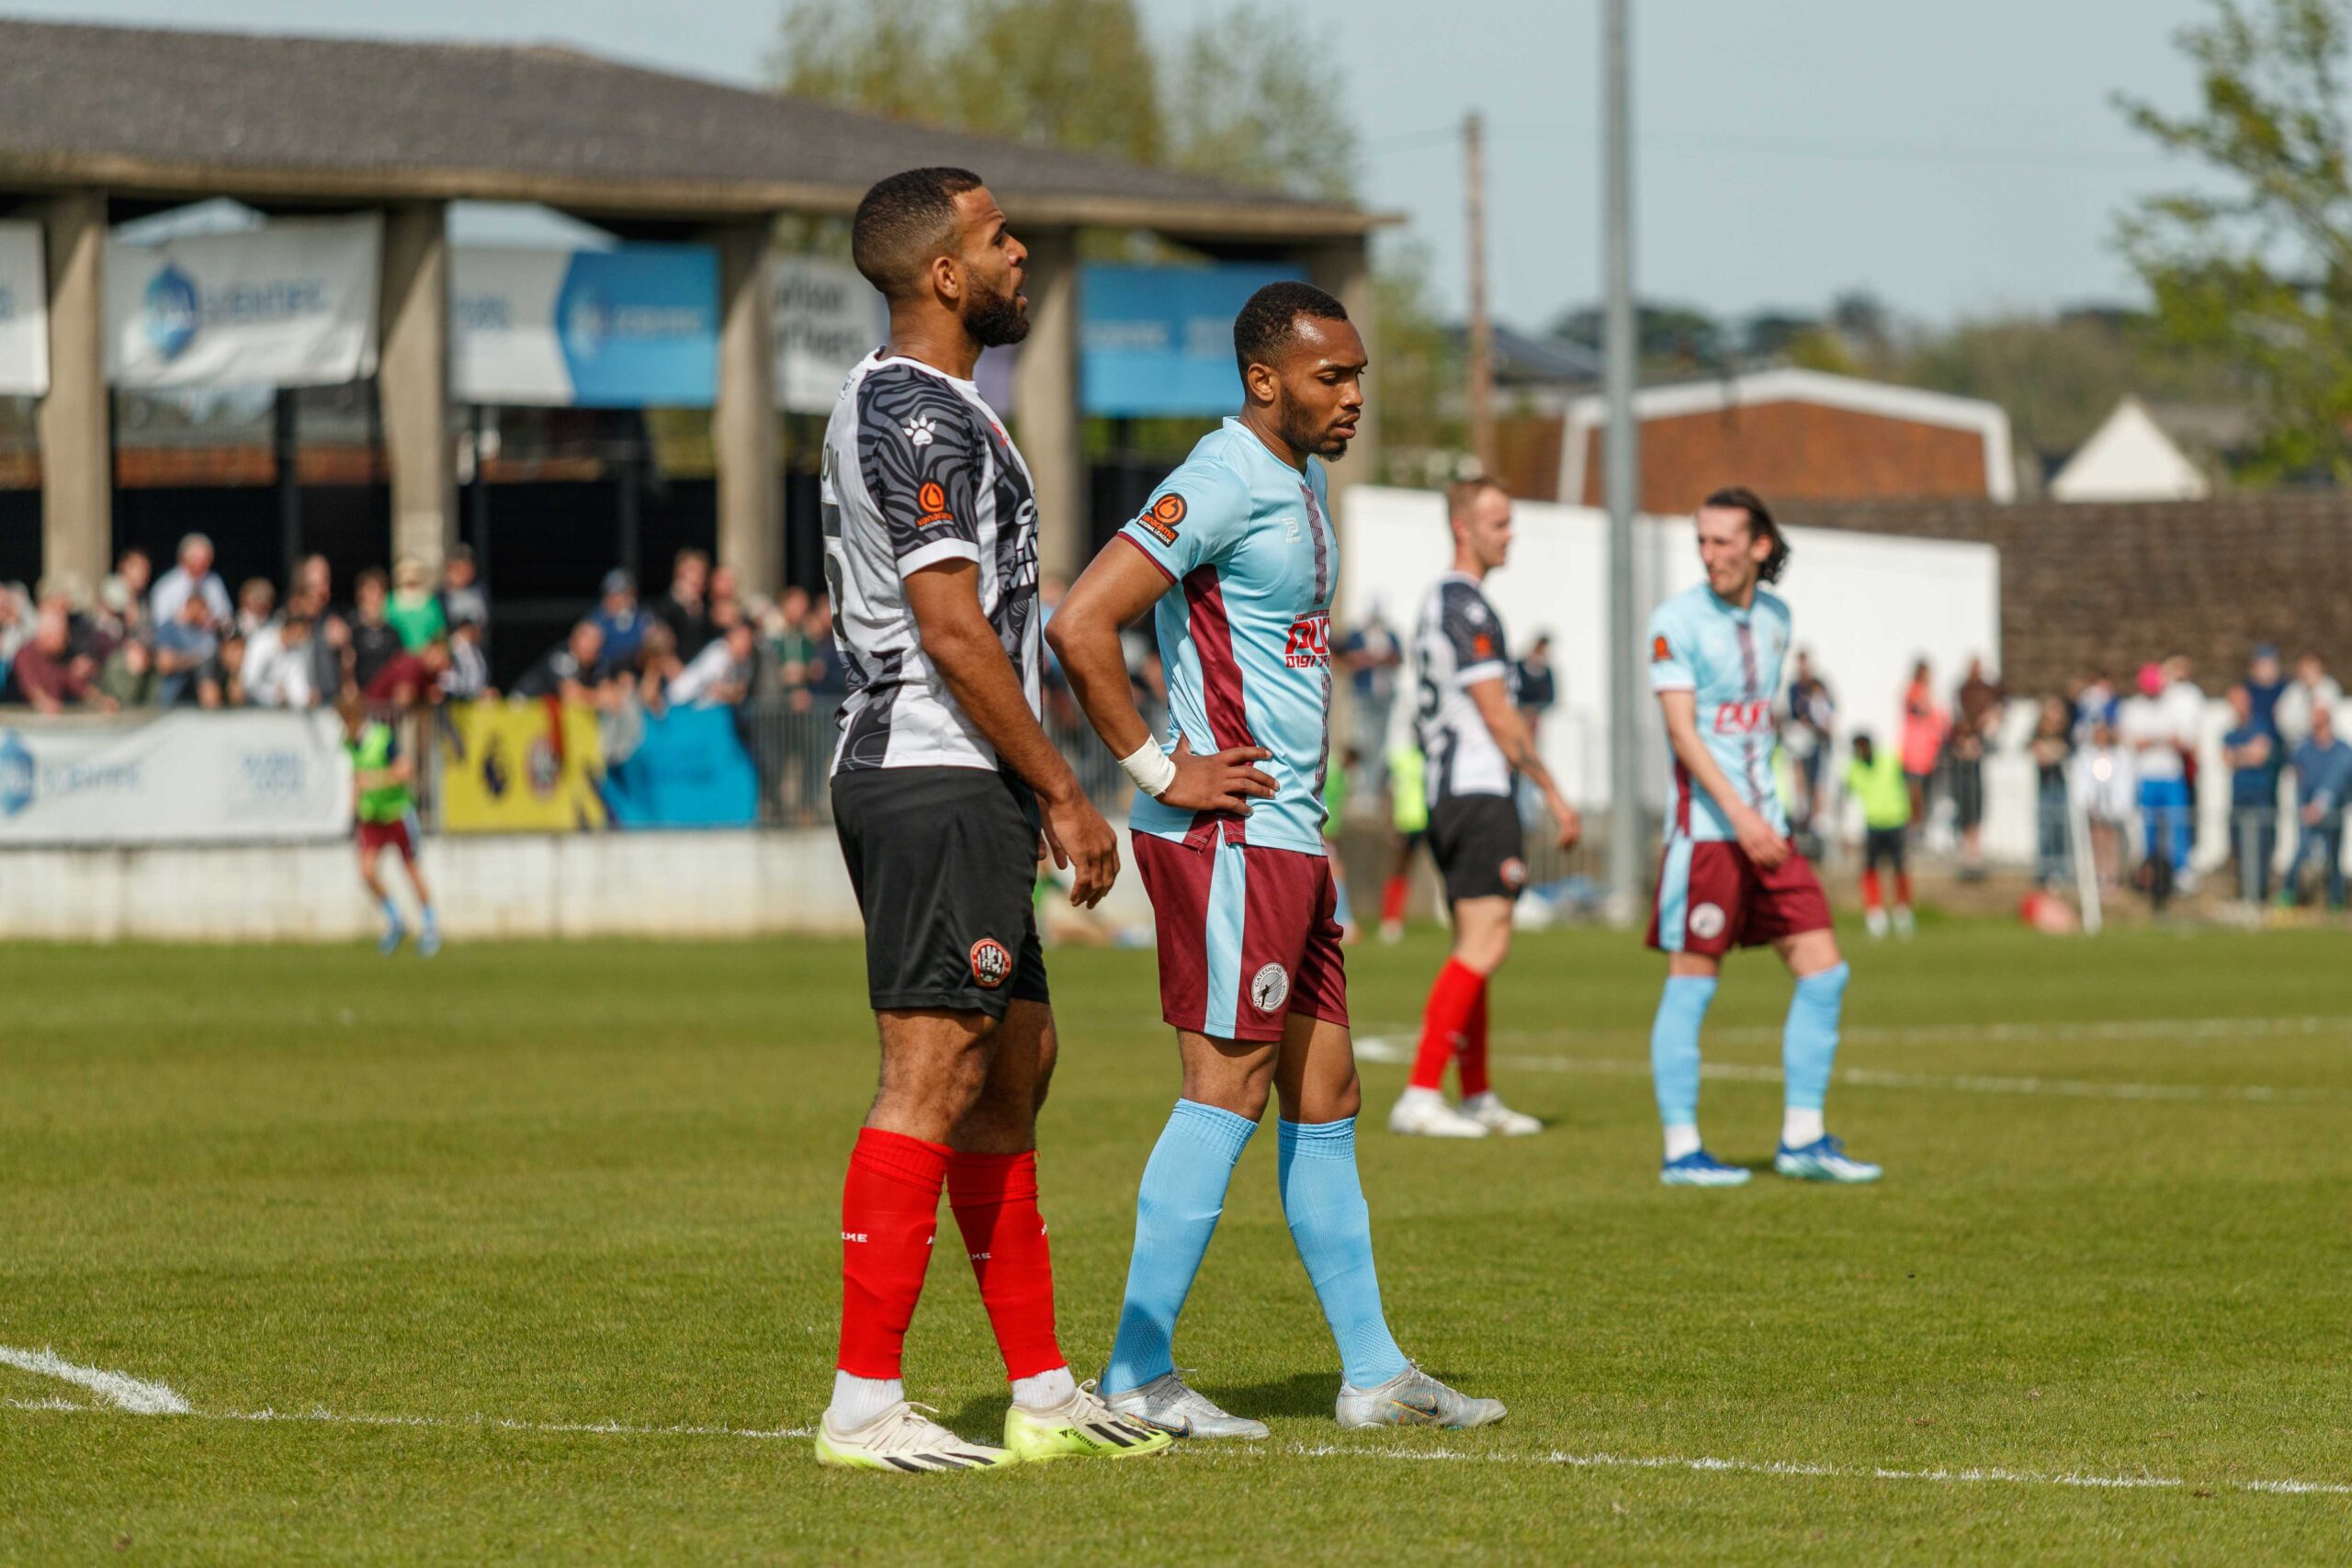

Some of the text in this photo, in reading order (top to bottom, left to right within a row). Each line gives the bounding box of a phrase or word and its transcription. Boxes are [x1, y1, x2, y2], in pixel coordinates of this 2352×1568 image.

[1154, 528, 1171, 544] LEAGUE
[1285, 655, 1317, 668] 0191
[1255, 965, 1283, 987] GATESHEAD
